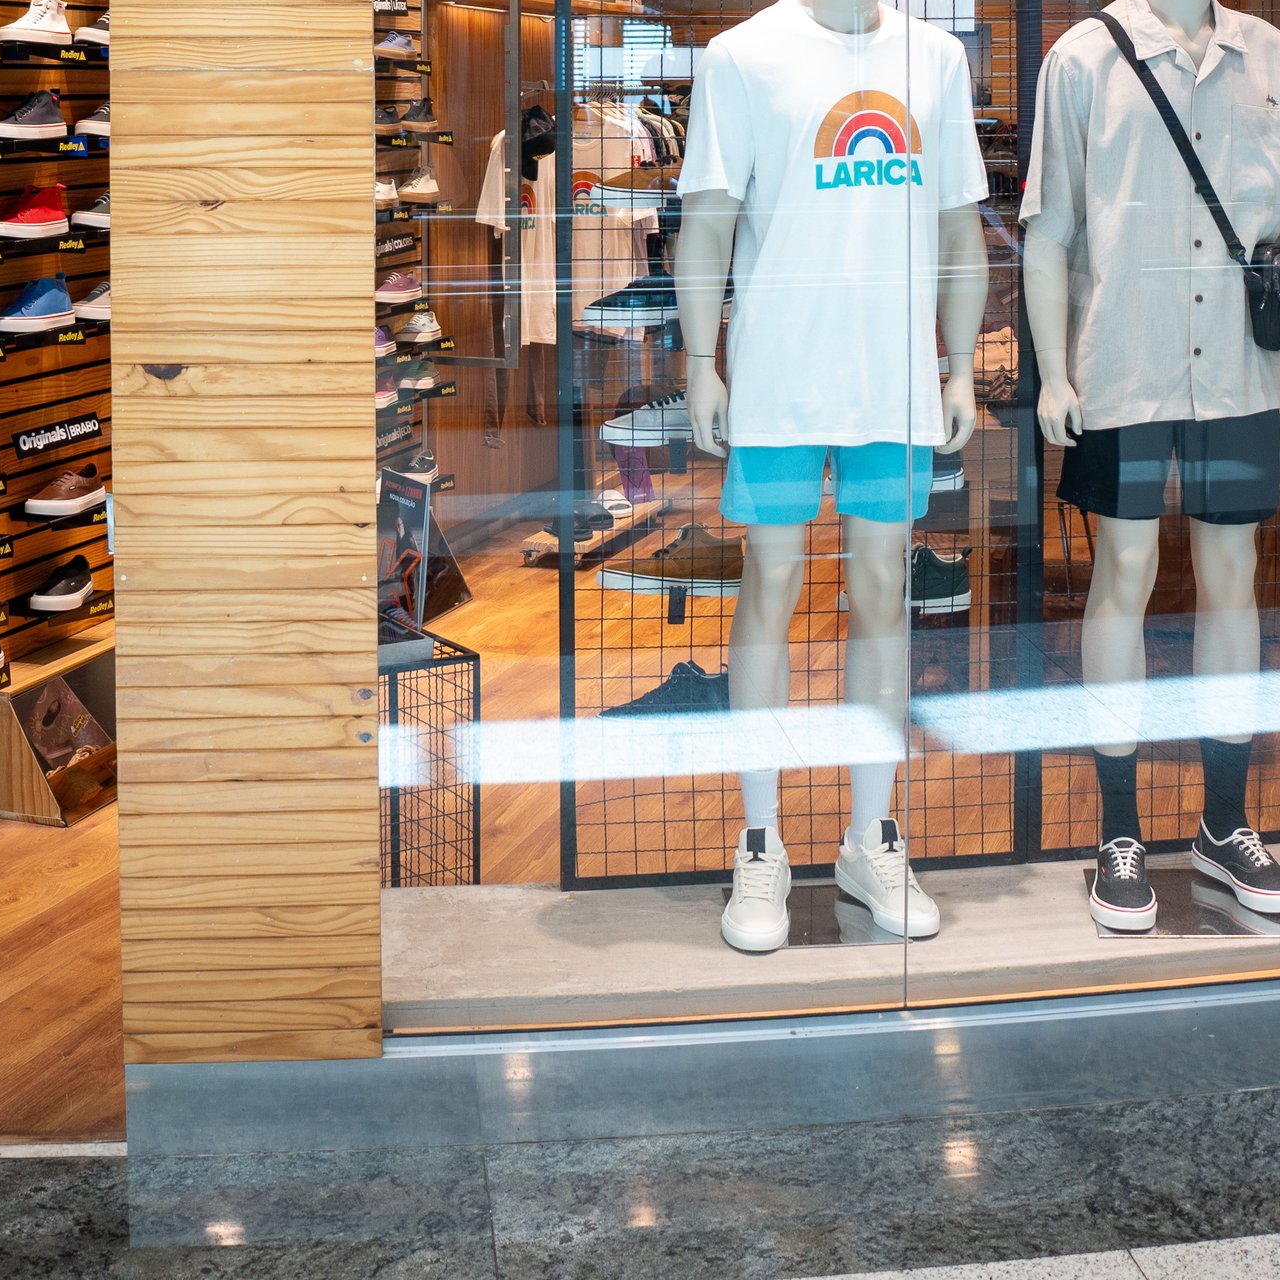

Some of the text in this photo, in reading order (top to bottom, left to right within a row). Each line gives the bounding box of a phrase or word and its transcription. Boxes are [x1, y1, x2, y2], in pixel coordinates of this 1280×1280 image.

[816, 159, 923, 190] LARICA
[572, 203, 609, 217] RICA
[19, 419, 99, 451] Originals BRABO
